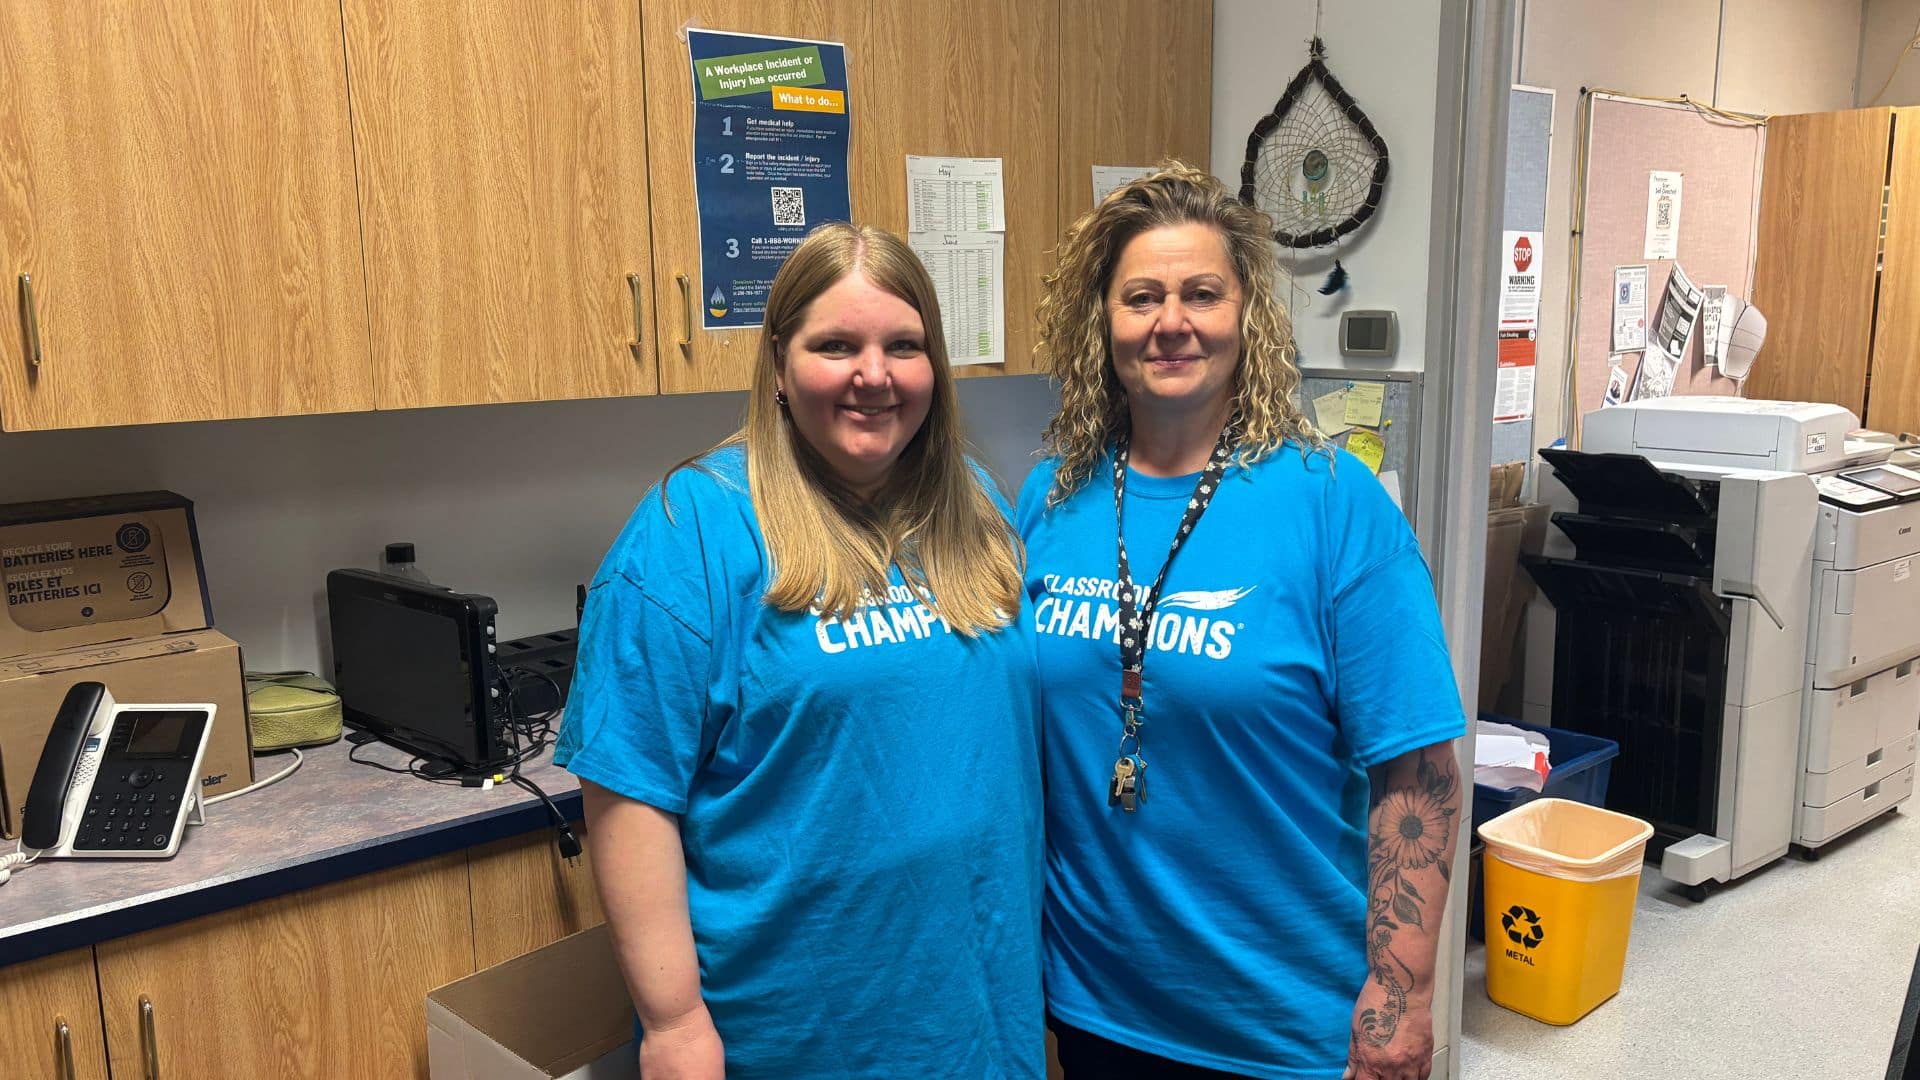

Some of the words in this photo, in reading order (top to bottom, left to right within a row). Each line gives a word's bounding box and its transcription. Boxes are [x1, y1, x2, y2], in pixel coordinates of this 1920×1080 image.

[705, 67, 713, 77] A
[714, 62, 763, 76] Workplace
[766, 57, 801, 70] Incident
[804, 56, 813, 65] or
[719, 77, 746, 90] Injury
[748, 76, 765, 85] has
[767, 69, 807, 83] occurred
[778, 93, 802, 105] What
[806, 96, 815, 105] to
[722, 116, 733, 136] 1
[746, 117, 757, 125] Get
[758, 118, 781, 126] medical
[781, 119, 794, 127] help
[720, 154, 734, 174] 2
[745, 152, 765, 161] Report
[766, 153, 776, 161] the
[938, 167, 952, 178] May
[725, 238, 740, 259] 3
[1514, 247, 1532, 262] STOP
[1508, 275, 1535, 285] WARNING
[2, 543, 43, 557] RECYCLE
[45, 541, 73, 551] YOUR
[3, 549, 75, 568] BATTERIES
[79, 545, 113, 559] HERE
[7, 569, 51, 582] RECYCLEZ
[54, 567, 74, 576] VOS
[7, 578, 43, 593] PILES
[47, 576, 63, 588] ET
[9, 585, 80, 606] BATTERIES
[84, 584, 102, 596] ICI
[1035, 597, 1236, 660] CHAMIONS
[1505, 948, 1535, 967] METAL
